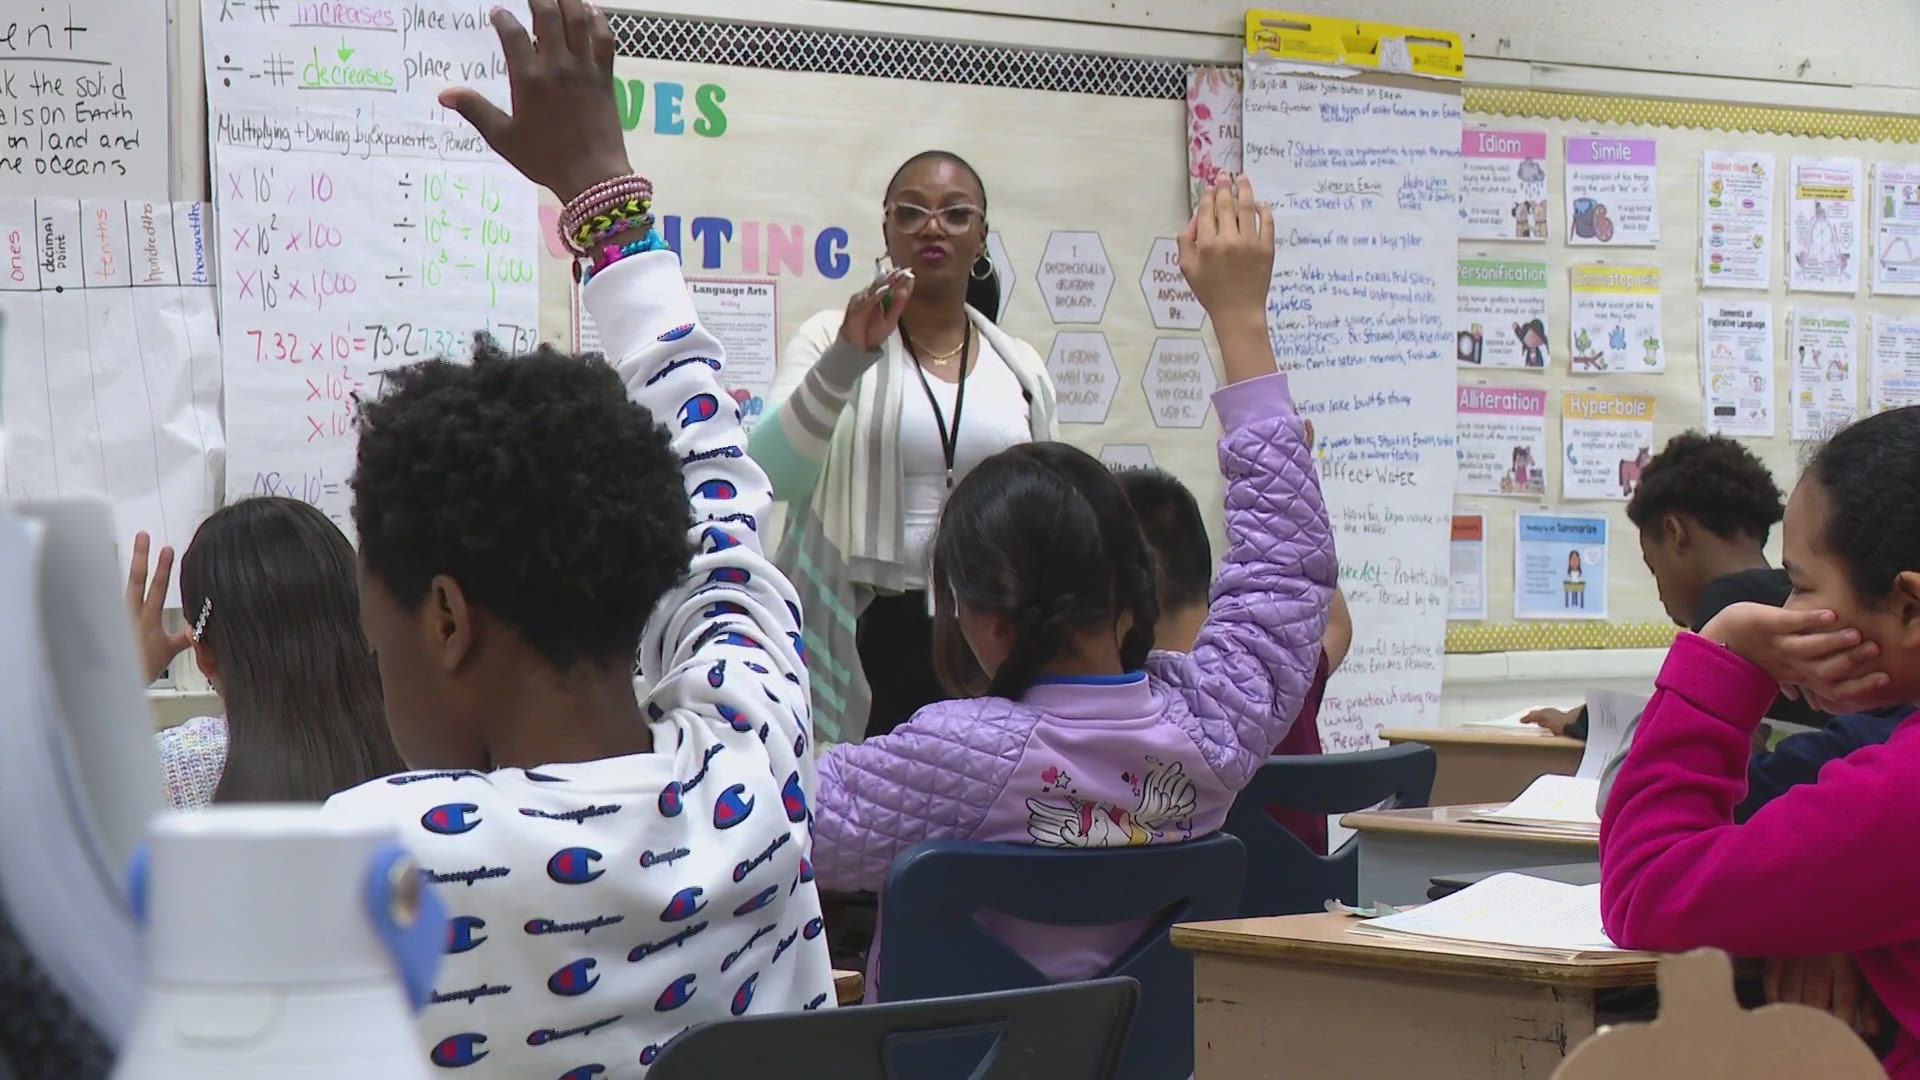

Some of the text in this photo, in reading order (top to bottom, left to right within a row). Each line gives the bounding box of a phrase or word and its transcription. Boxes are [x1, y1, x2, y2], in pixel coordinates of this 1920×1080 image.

[452, 8, 494, 31] valu
[303, 46, 394, 88] decreases
[461, 52, 508, 80] valu
[0, 67, 126, 100] k the solid
[40, 128, 88, 151] land
[100, 130, 139, 151] and
[217, 112, 292, 152] Multiplying
[1478, 132, 1521, 154] Idiom
[35, 155, 126, 176] oceans
[1591, 141, 1632, 161] Simile
[310, 172, 333, 201] 10
[41, 216, 54, 273] decimal
[96, 208, 115, 280] tenths
[307, 217, 342, 249] 100
[481, 217, 511, 246] 100
[10, 231, 24, 281] ones
[57, 234, 67, 269] point
[693, 284, 768, 297] Language Arts
[247, 330, 302, 364] 7.32
[1459, 388, 1539, 411] Alliteration
[1570, 394, 1647, 418] Hyperbole
[420, 866, 511, 887] hampion
[430, 984, 512, 1005] hampion
